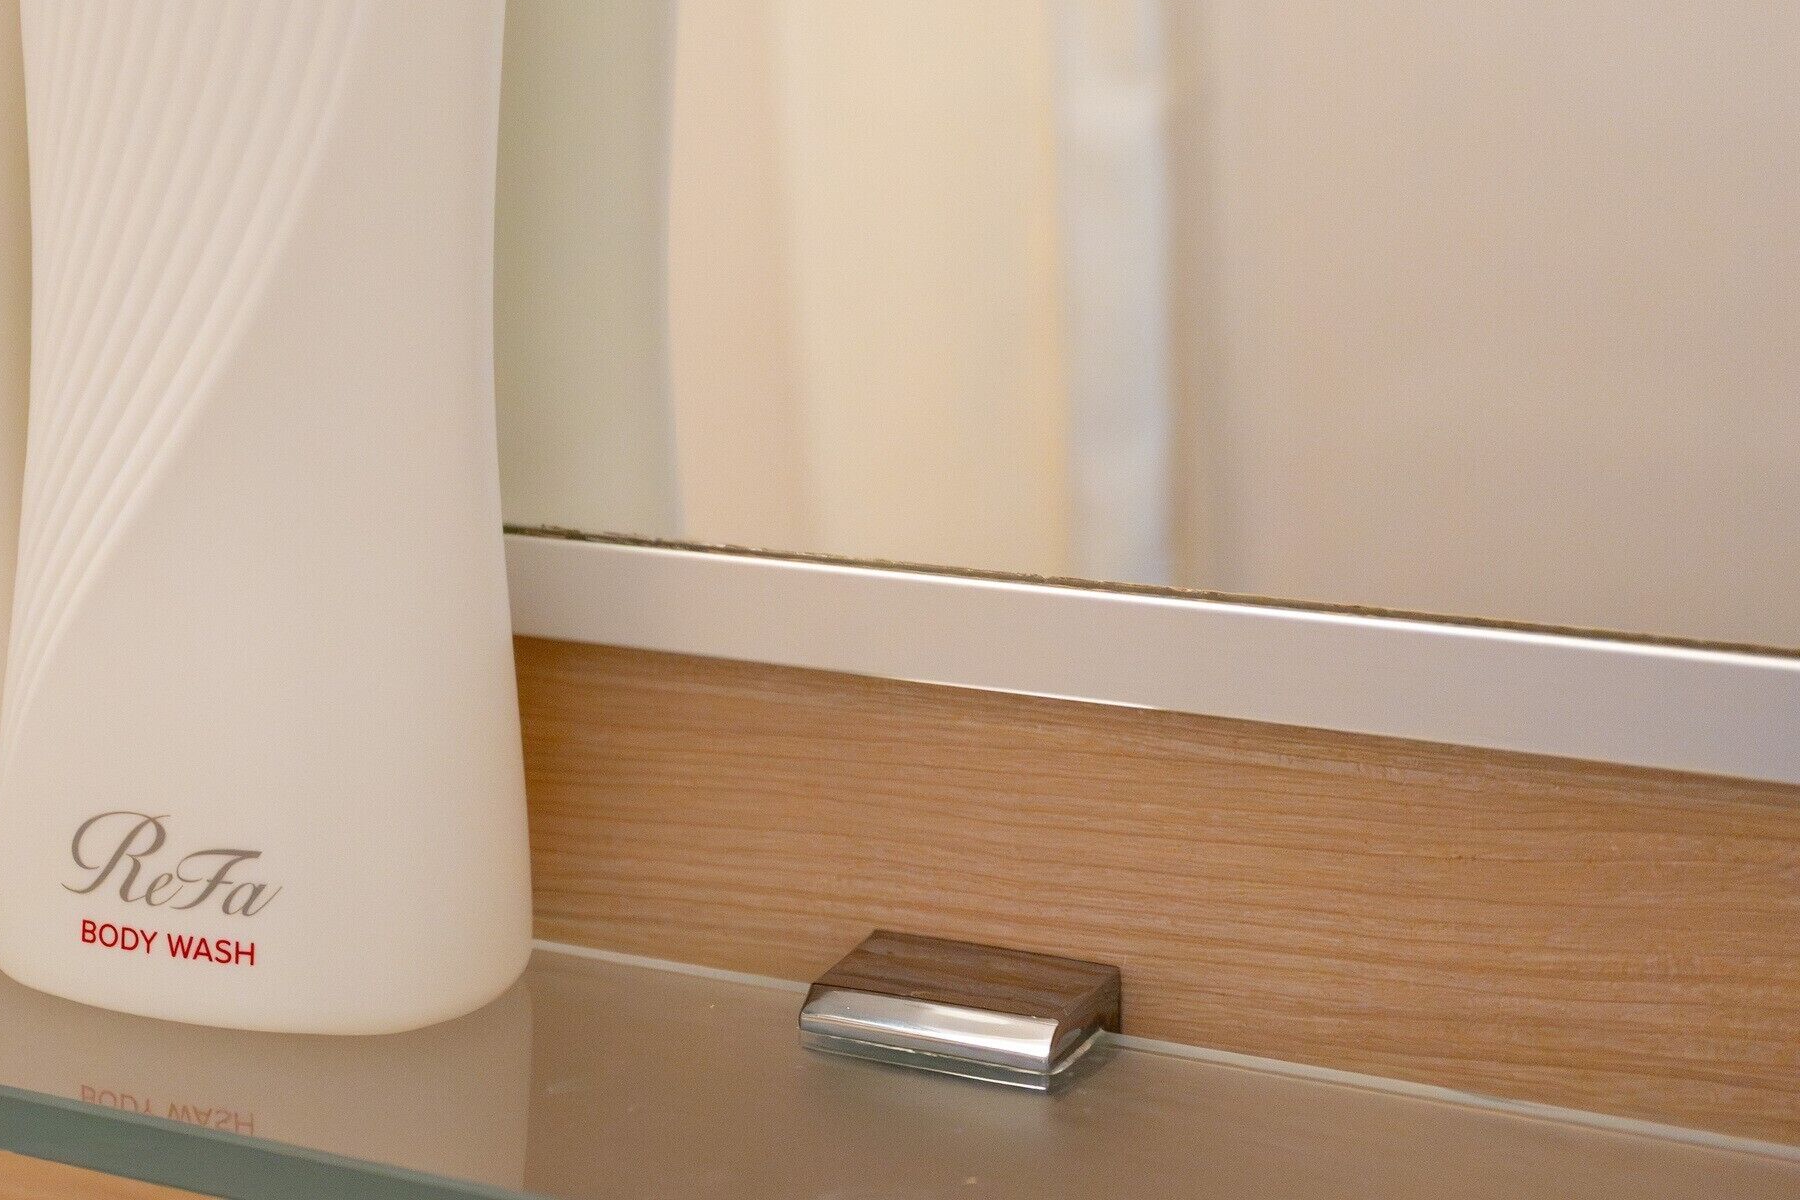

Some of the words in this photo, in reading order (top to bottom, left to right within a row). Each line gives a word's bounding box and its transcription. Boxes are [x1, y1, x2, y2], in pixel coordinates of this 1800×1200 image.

[60, 810, 283, 917] ReFa
[80, 918, 158, 954] BODY
[166, 933, 257, 967] WASH
